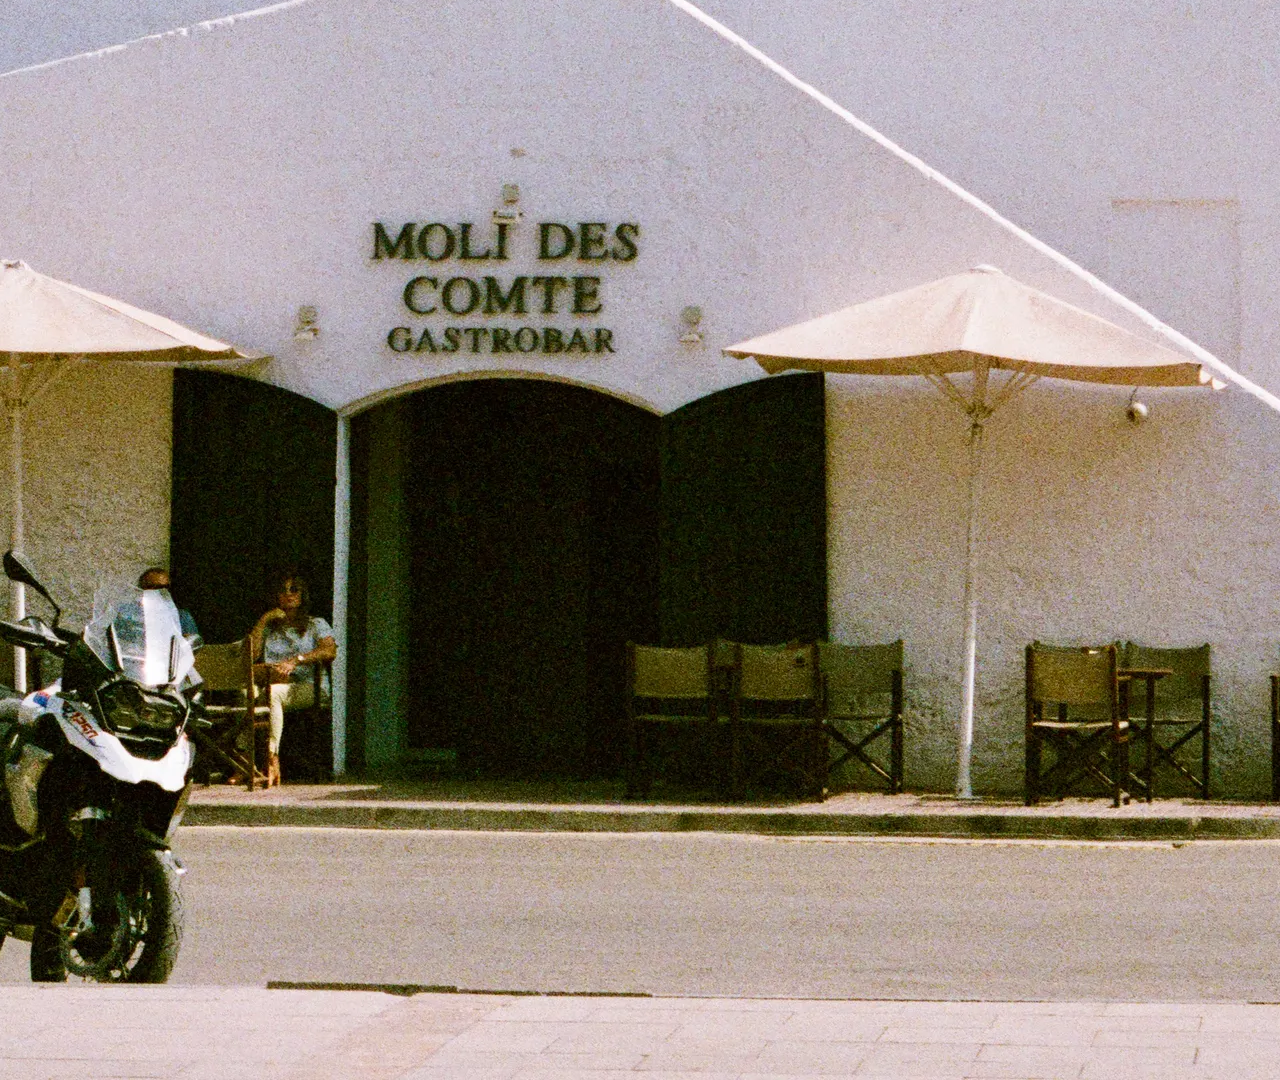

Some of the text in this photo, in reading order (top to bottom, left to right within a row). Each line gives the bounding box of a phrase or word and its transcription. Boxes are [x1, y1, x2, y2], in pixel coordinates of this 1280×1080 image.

[537, 222, 639, 261] DES
[403, 275, 603, 314] COMTE
[387, 327, 615, 352] GASTROBAR
